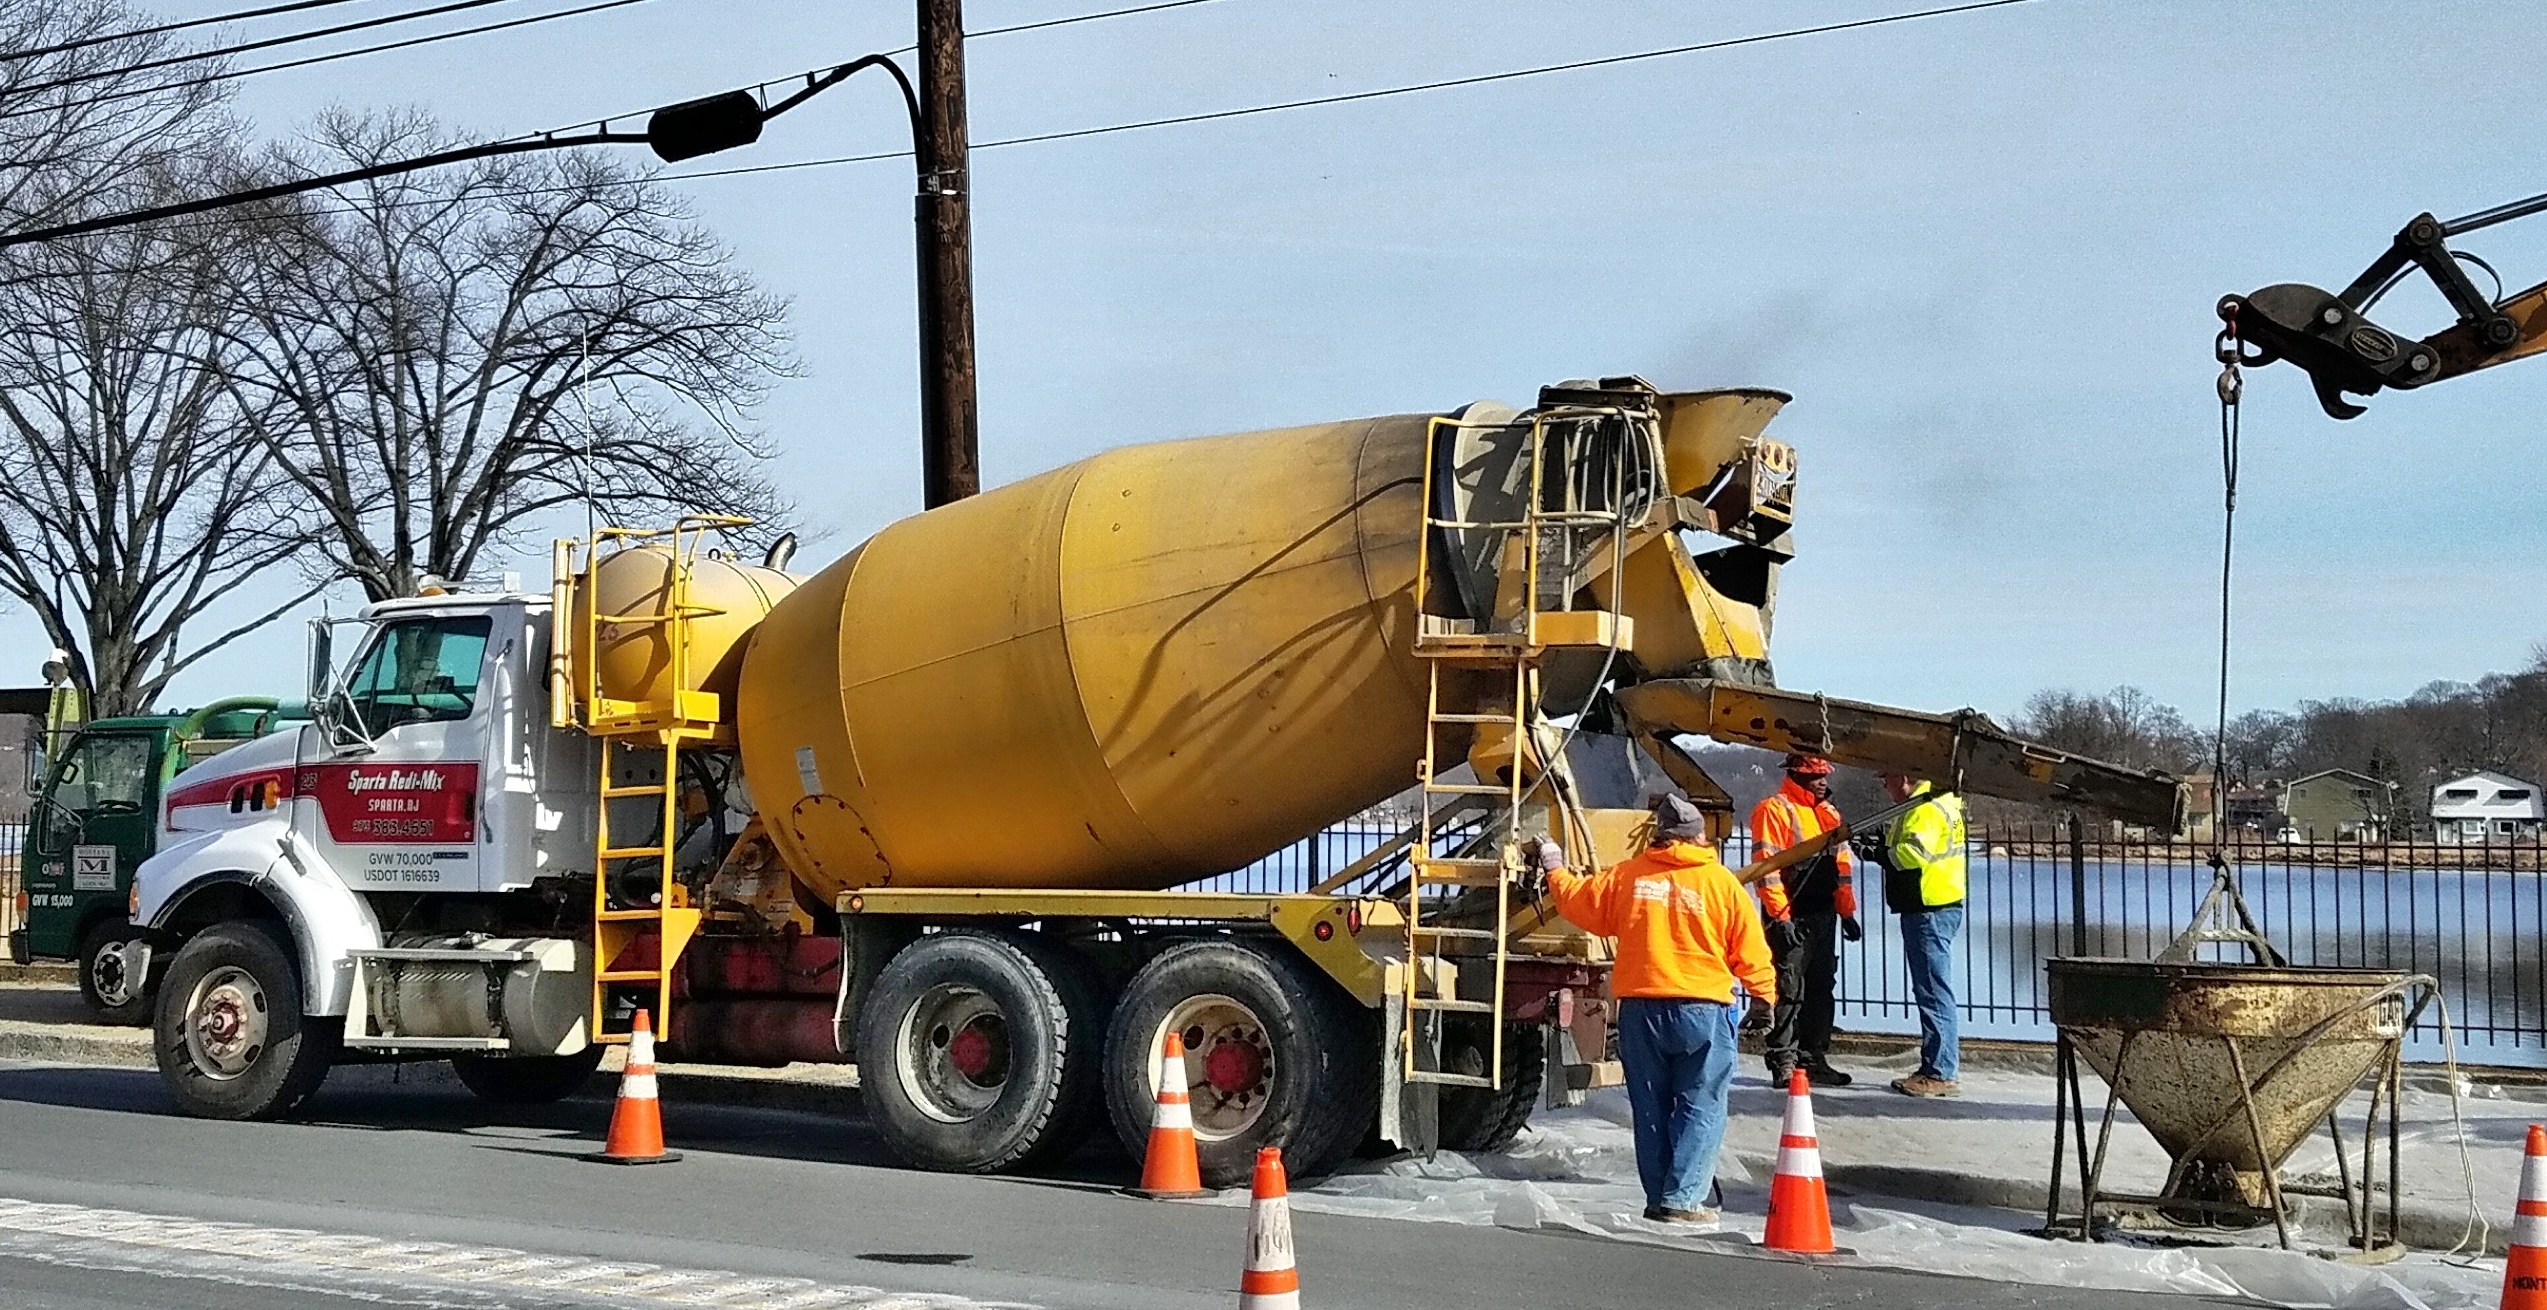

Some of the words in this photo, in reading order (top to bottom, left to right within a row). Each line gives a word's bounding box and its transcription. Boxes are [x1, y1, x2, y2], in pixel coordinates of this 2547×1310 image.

[300, 773, 318, 790] 23
[348, 769, 387, 795] Sparta
[388, 769, 446, 791] Redi-Mix
[80, 859, 108, 871] M
[368, 853, 393, 865] GVW
[363, 869, 399, 881] USDOT
[401, 869, 440, 882] 1616639
[32, 894, 48, 906] GVW
